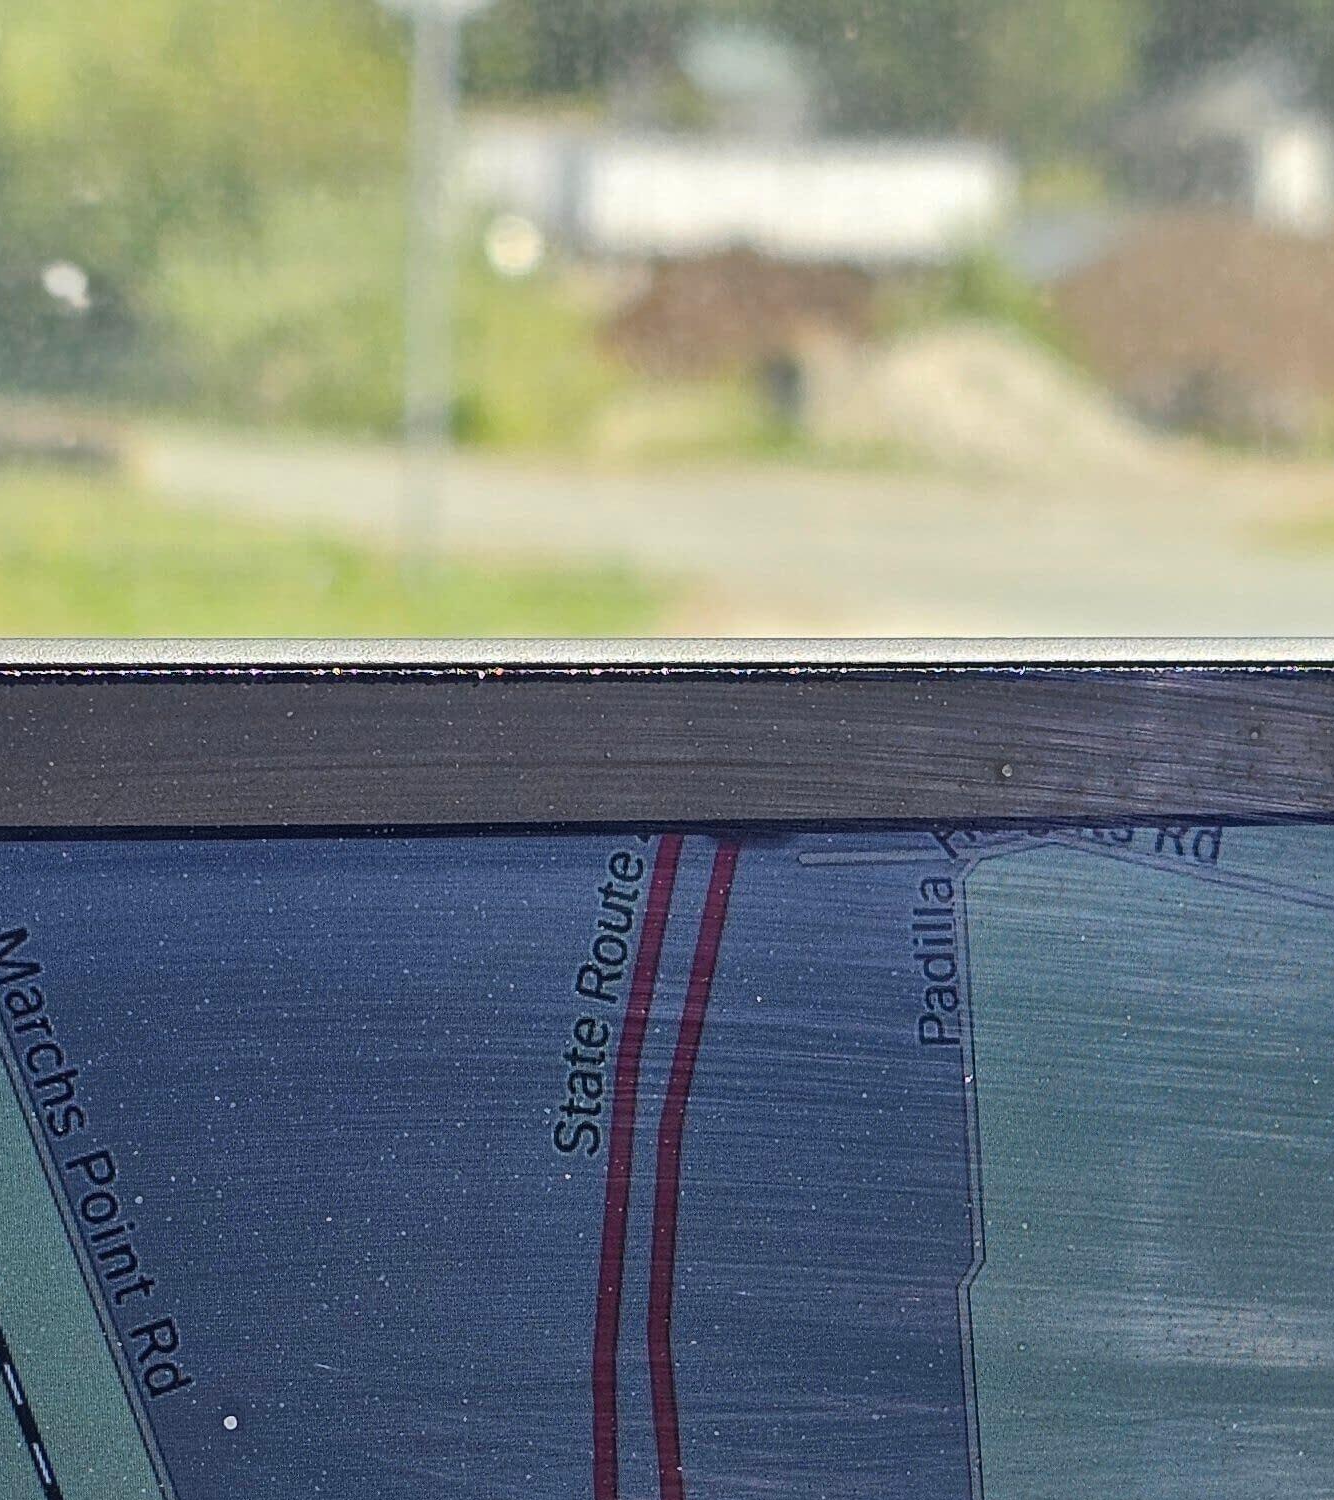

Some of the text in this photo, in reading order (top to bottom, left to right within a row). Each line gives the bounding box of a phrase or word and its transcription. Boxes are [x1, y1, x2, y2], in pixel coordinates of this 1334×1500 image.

[555, 850, 646, 1156] State Route
[913, 876, 960, 1047] Padilla
[67, 1150, 154, 1306] Point
[129, 1318, 193, 1397] Rd
